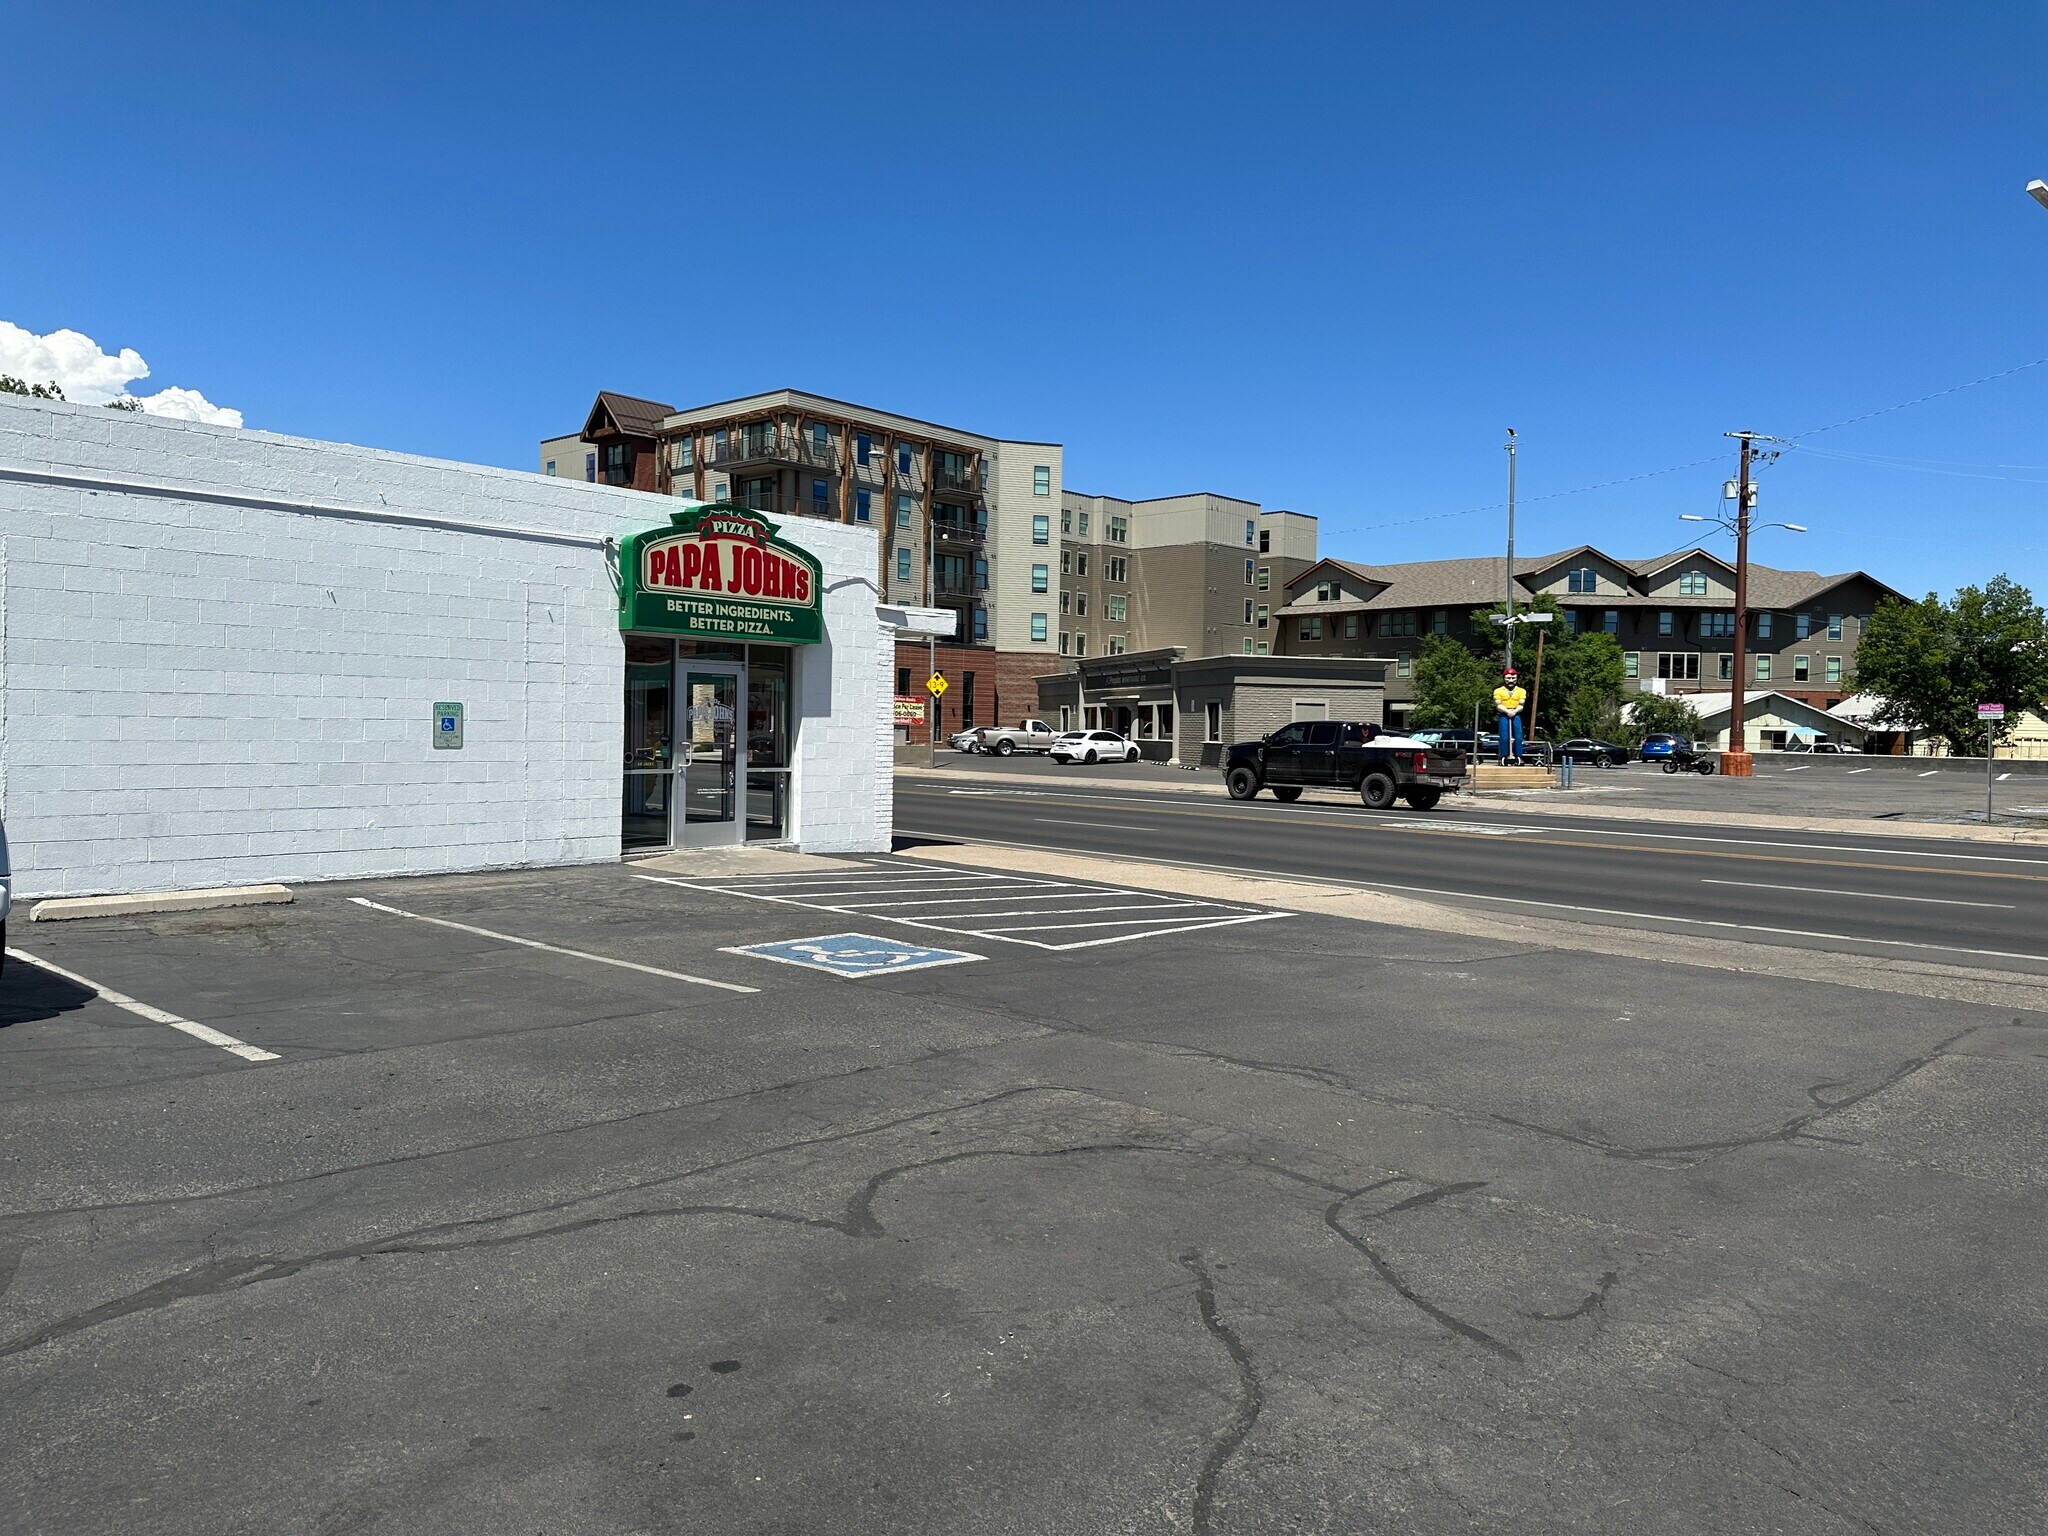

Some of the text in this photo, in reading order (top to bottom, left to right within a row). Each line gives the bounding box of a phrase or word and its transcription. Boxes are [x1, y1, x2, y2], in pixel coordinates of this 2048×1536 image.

[711, 520, 756, 539] PIZZA
[650, 543, 809, 601] PAPA JOHN'S
[666, 600, 794, 622] BETTER INGREDIENTS.
[689, 616, 774, 635] BETTER PIZZA.
